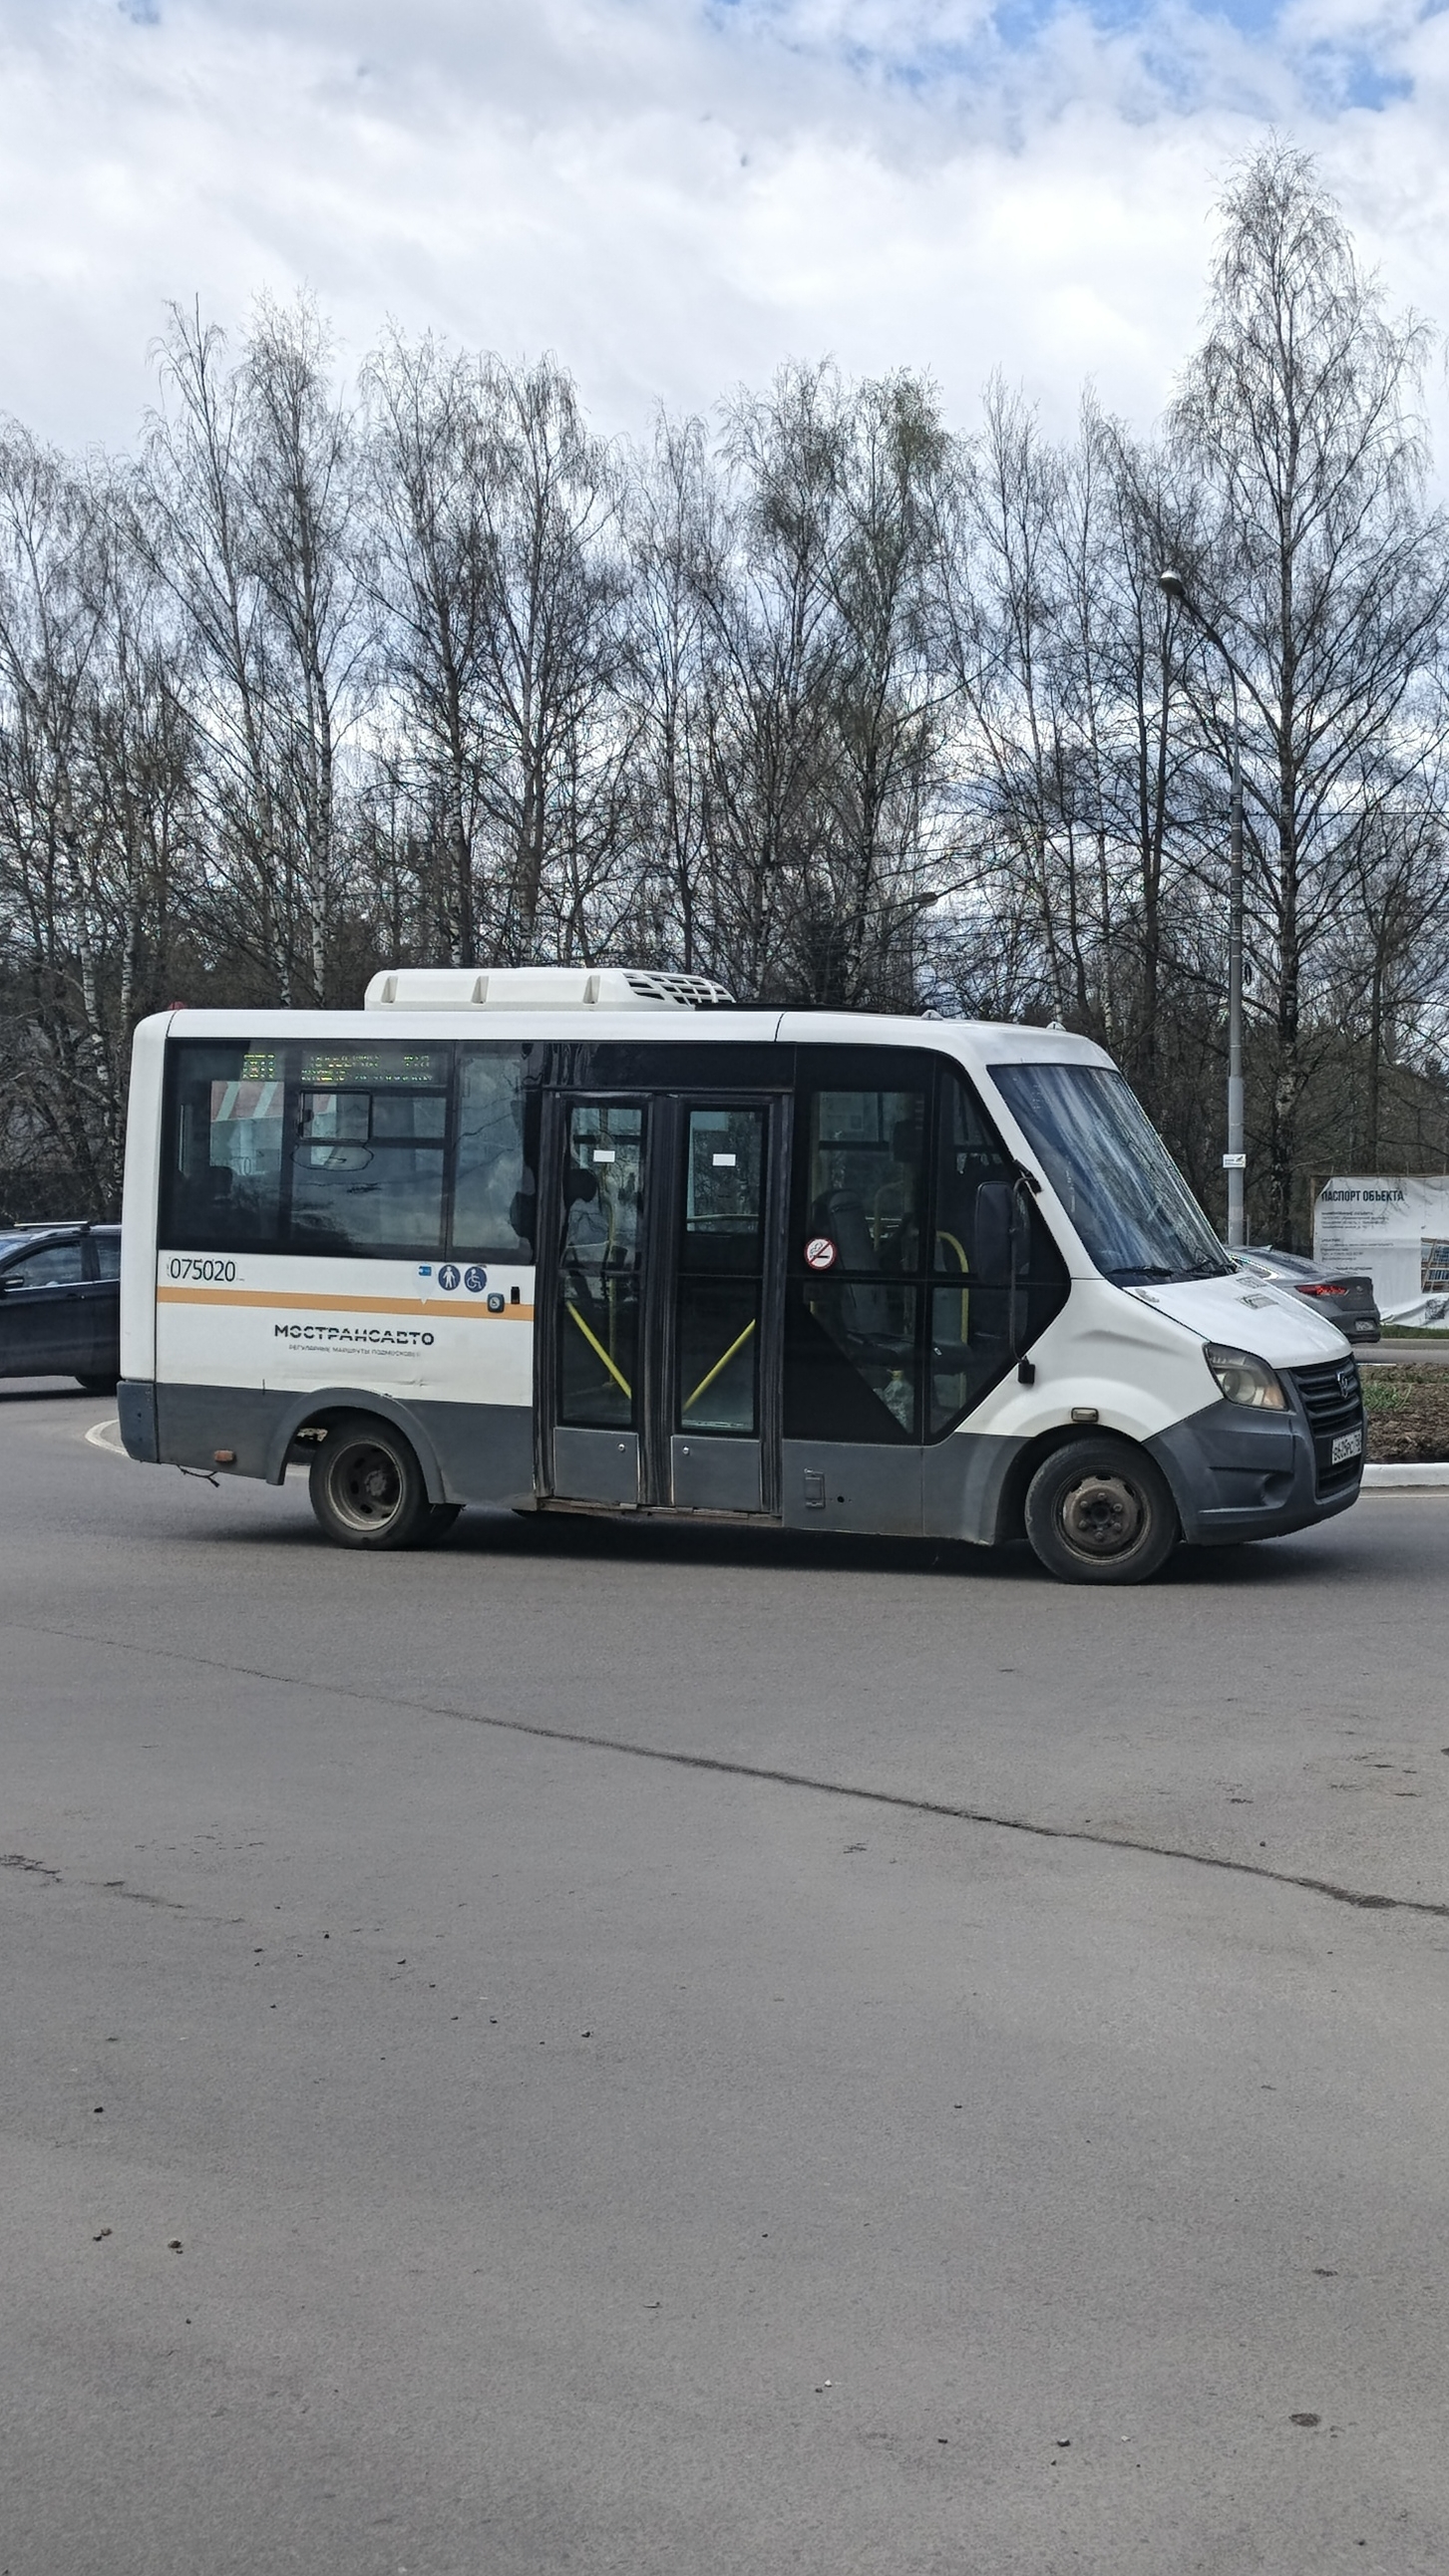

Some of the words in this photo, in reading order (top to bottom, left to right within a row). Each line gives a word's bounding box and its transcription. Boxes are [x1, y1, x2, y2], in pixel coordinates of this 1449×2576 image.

[1321, 1189, 1361, 1202] ПАСПОРТ
[1362, 1189, 1405, 1202] ОБЪЕКТА
[170, 1258, 236, 1282] 075020
[274, 1324, 435, 1346] МОСТРАНСАВТО
